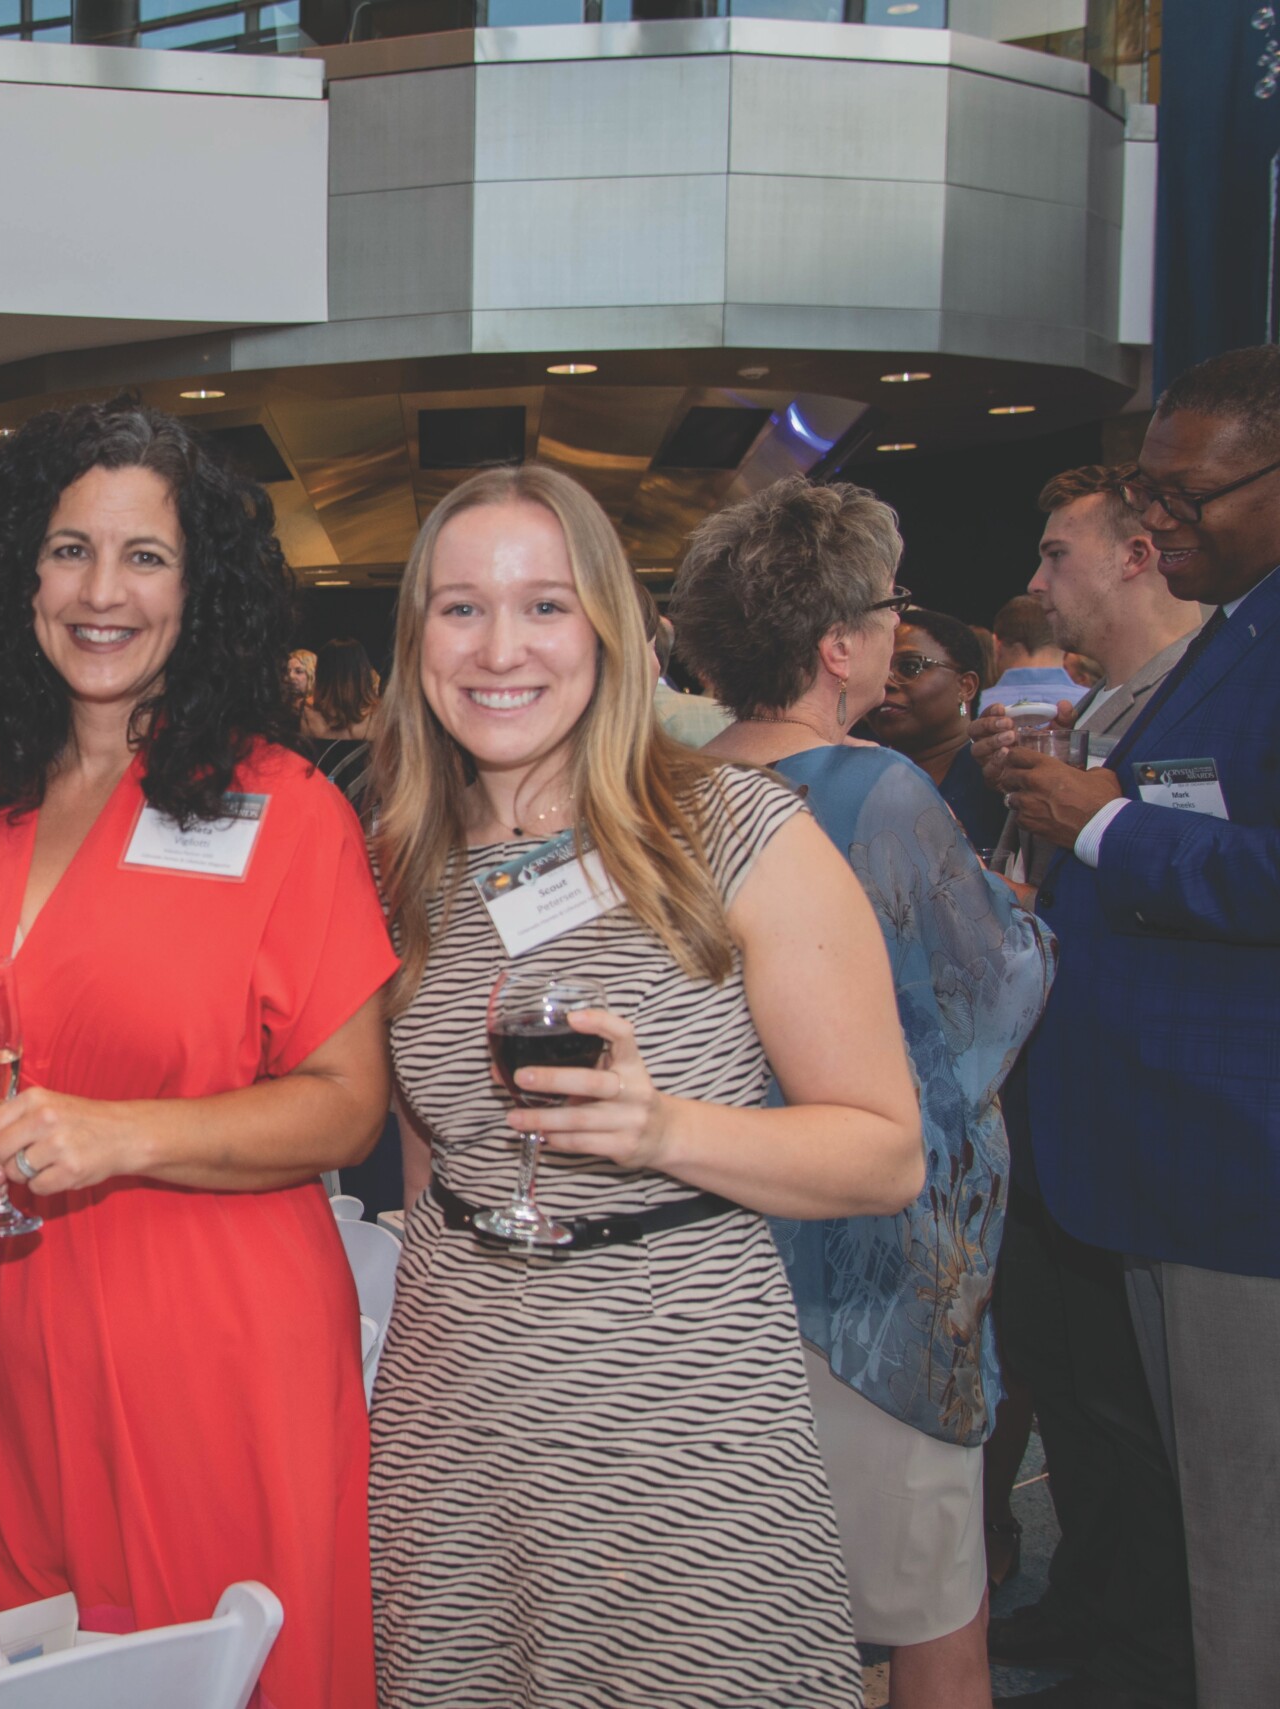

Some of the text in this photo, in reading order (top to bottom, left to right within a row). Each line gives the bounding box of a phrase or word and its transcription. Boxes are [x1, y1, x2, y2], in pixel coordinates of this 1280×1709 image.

[1171, 791, 1190, 799] Mark
[538, 879, 568, 898] Scout
[537, 888, 582, 914] Petersen
